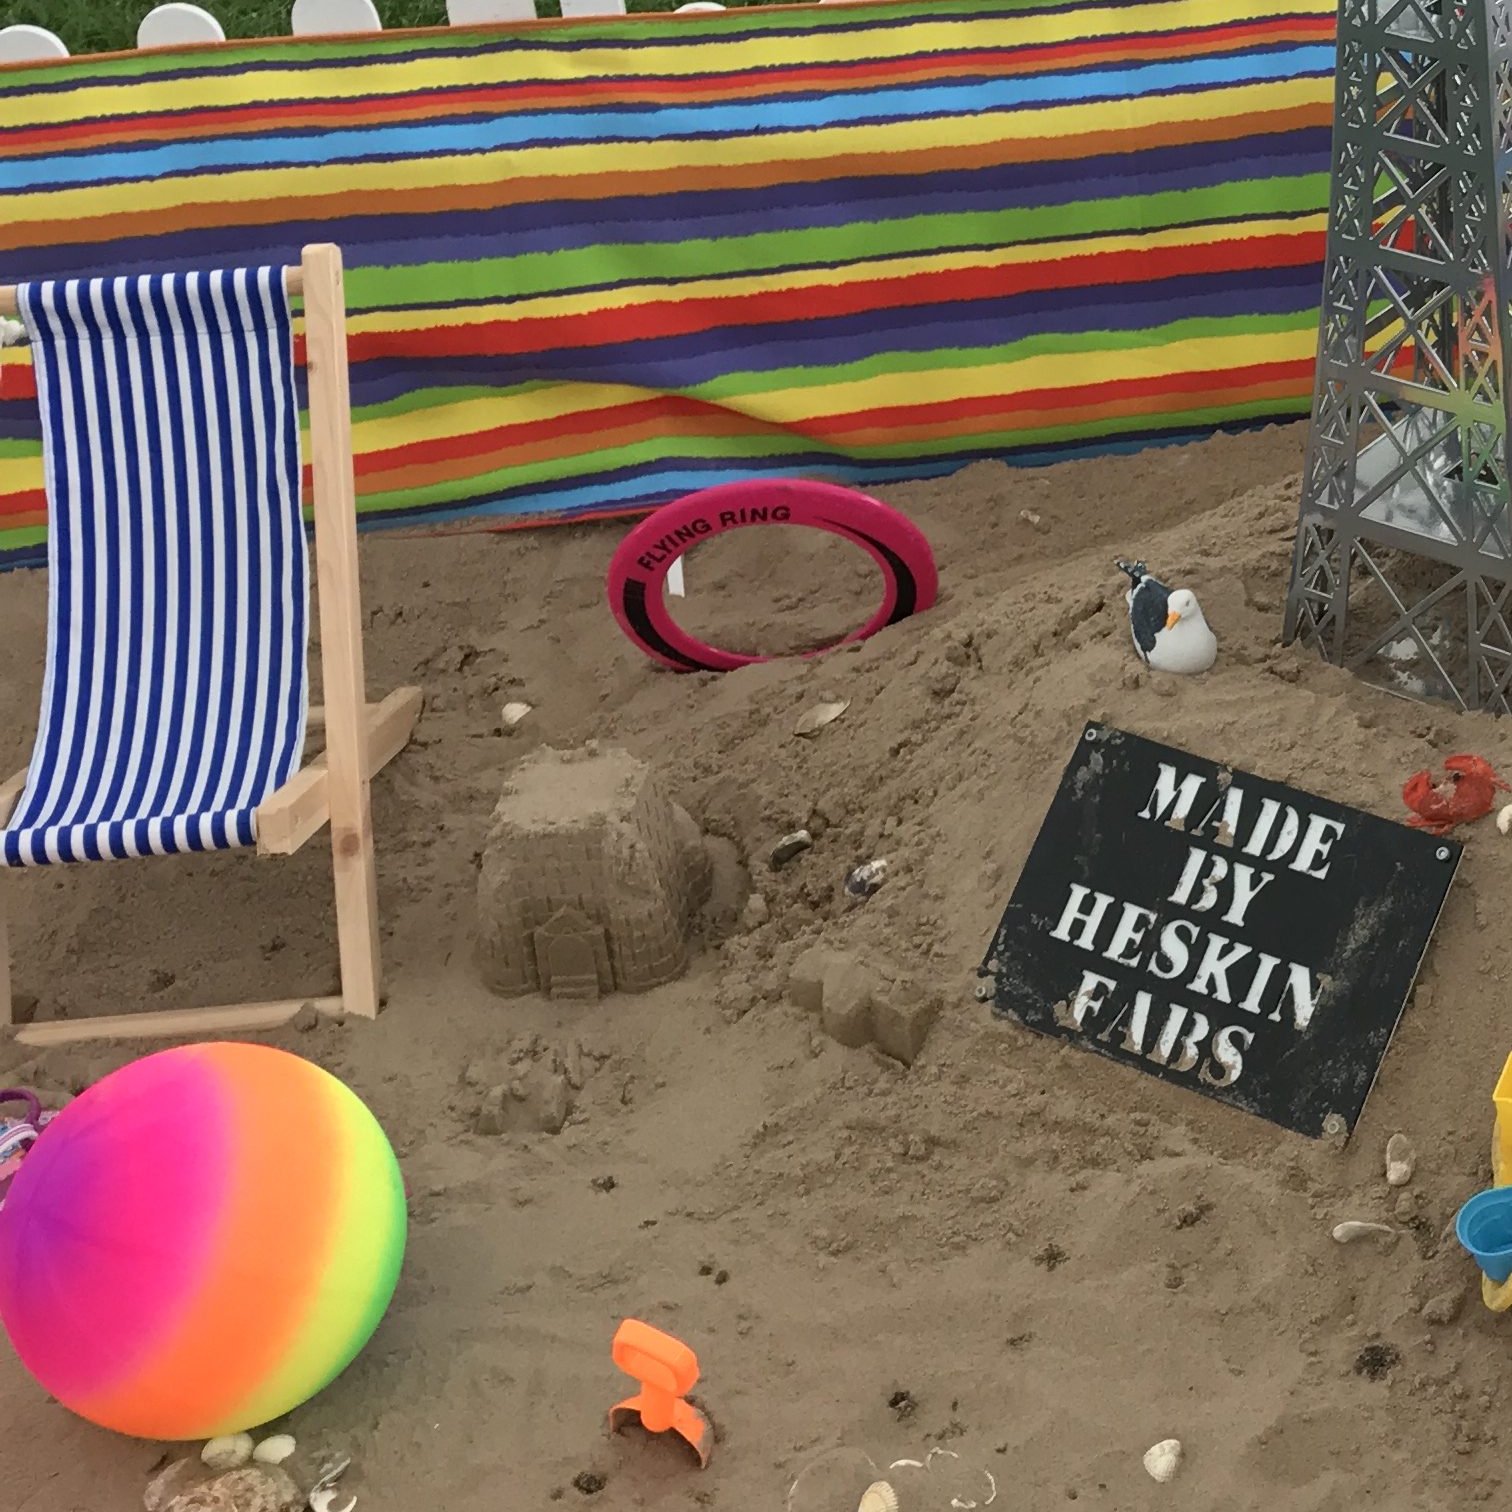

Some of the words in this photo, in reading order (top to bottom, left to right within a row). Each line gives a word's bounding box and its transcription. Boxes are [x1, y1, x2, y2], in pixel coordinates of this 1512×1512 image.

[636, 518, 713, 572] FLYING
[720, 505, 791, 527] RING
[1137, 762, 1346, 880] MADE
[1167, 846, 1275, 927] BY
[1049, 882, 1325, 1030] HESKIN
[1056, 970, 1256, 1087] FABS
